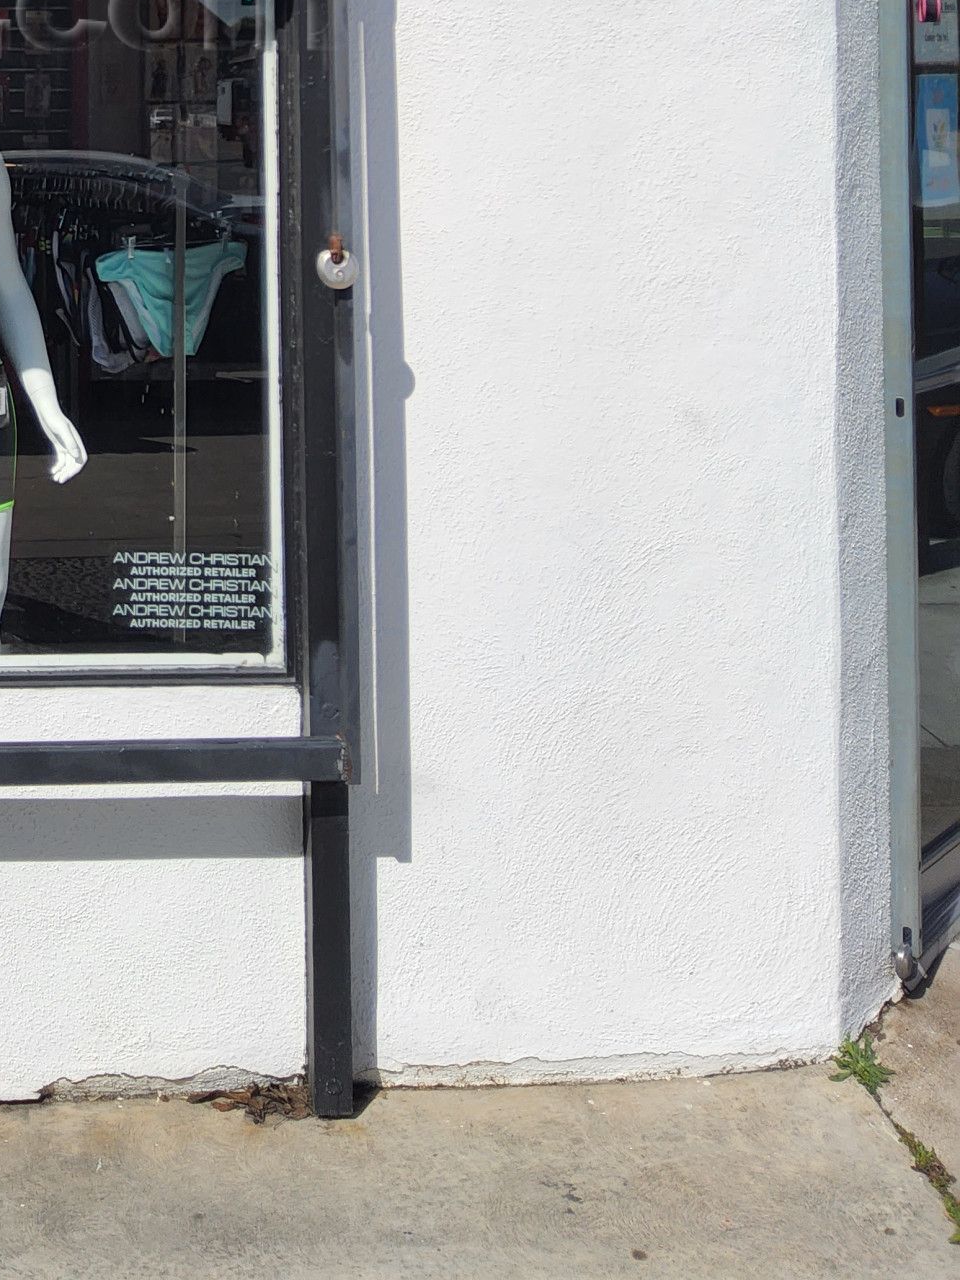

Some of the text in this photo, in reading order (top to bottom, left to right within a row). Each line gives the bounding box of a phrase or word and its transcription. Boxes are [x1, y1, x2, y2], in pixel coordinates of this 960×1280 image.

[113, 552, 185, 565] ANDREW
[130, 566, 257, 577] AUTHORIZED RETAILER
[113, 578, 185, 591] ANDREW
[130, 592, 256, 603] AUTHORIZED RETAILER
[113, 604, 185, 617] ANDREW
[130, 618, 256, 629] AUTHORIZED RETAILER
